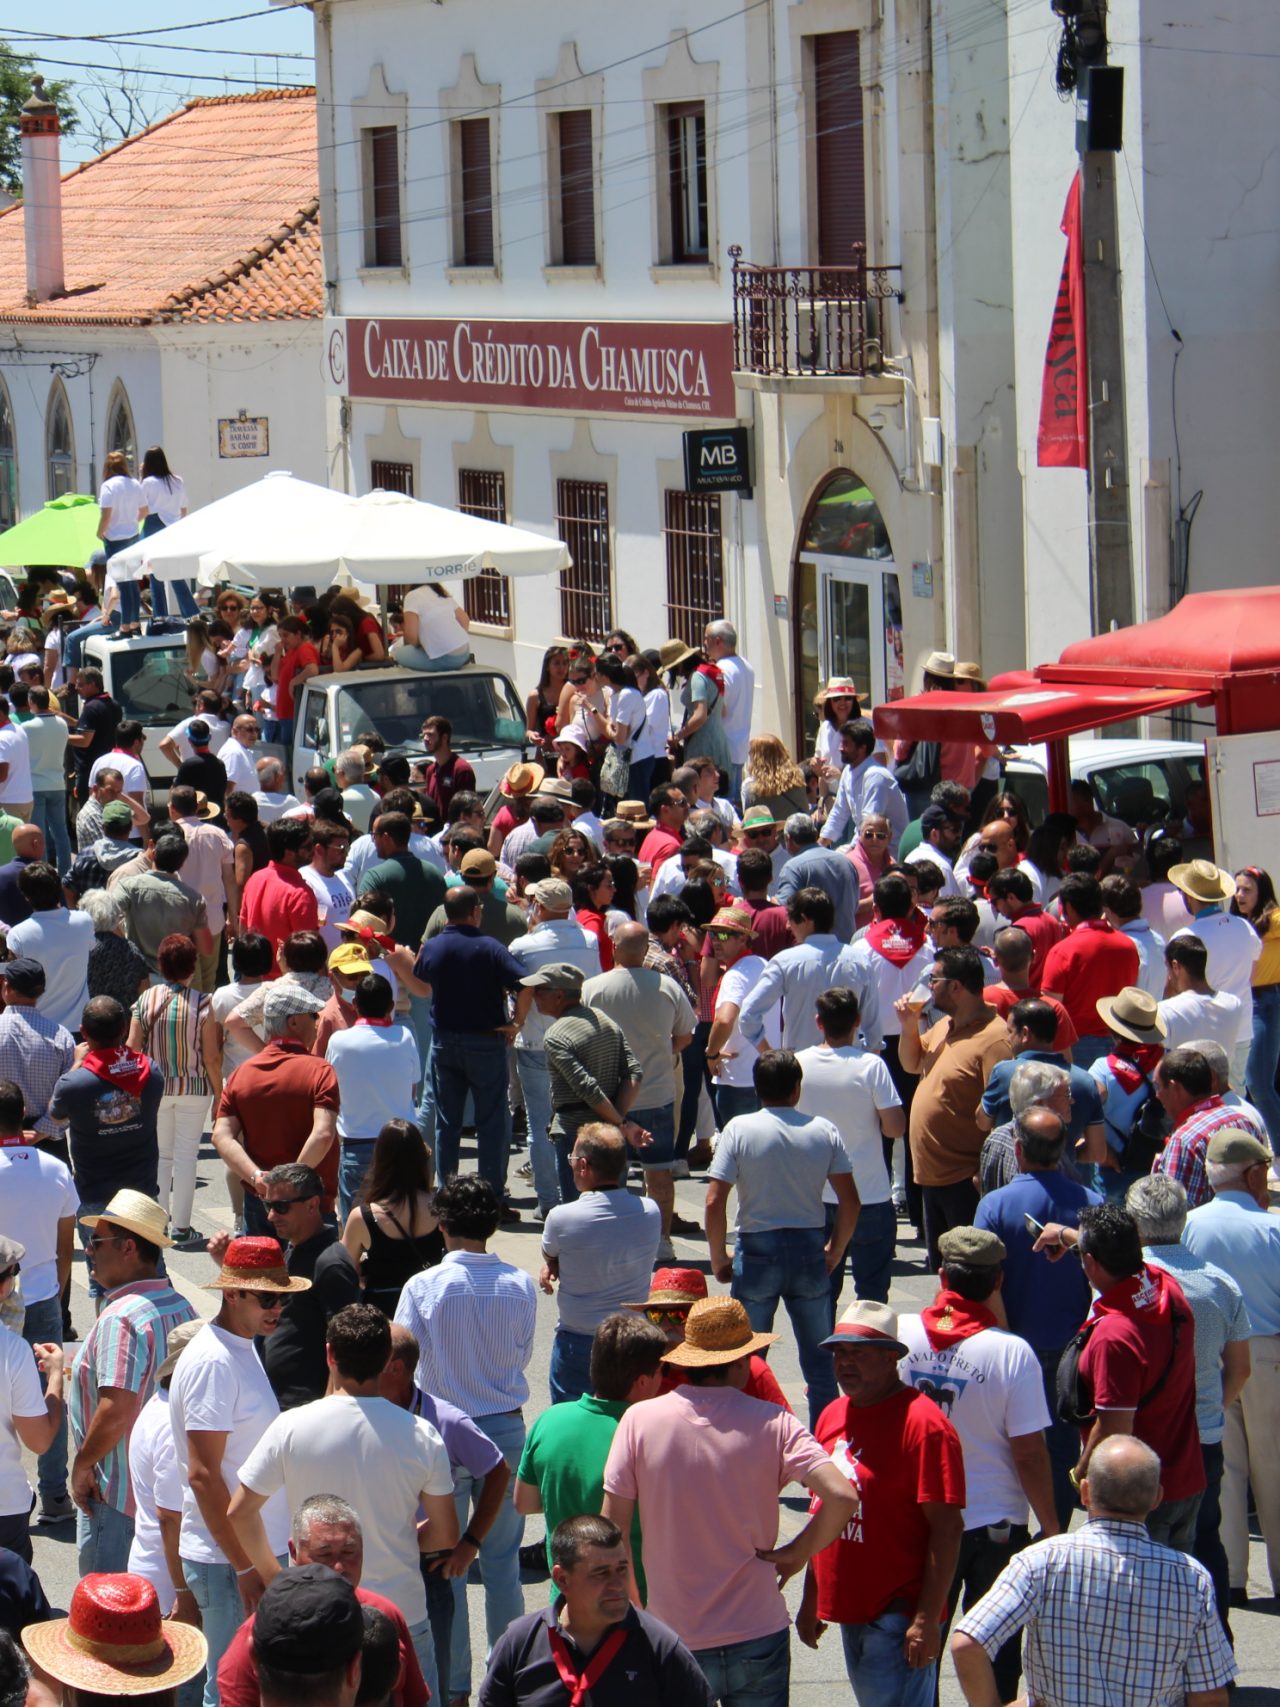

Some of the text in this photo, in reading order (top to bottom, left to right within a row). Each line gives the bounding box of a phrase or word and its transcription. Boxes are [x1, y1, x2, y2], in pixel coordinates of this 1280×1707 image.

[363, 320, 711, 396] CAIXA DE CRÉDITO DA CHAMUSCA
[700, 445, 737, 467] MB
[948, 1354, 986, 1384] PRETO
